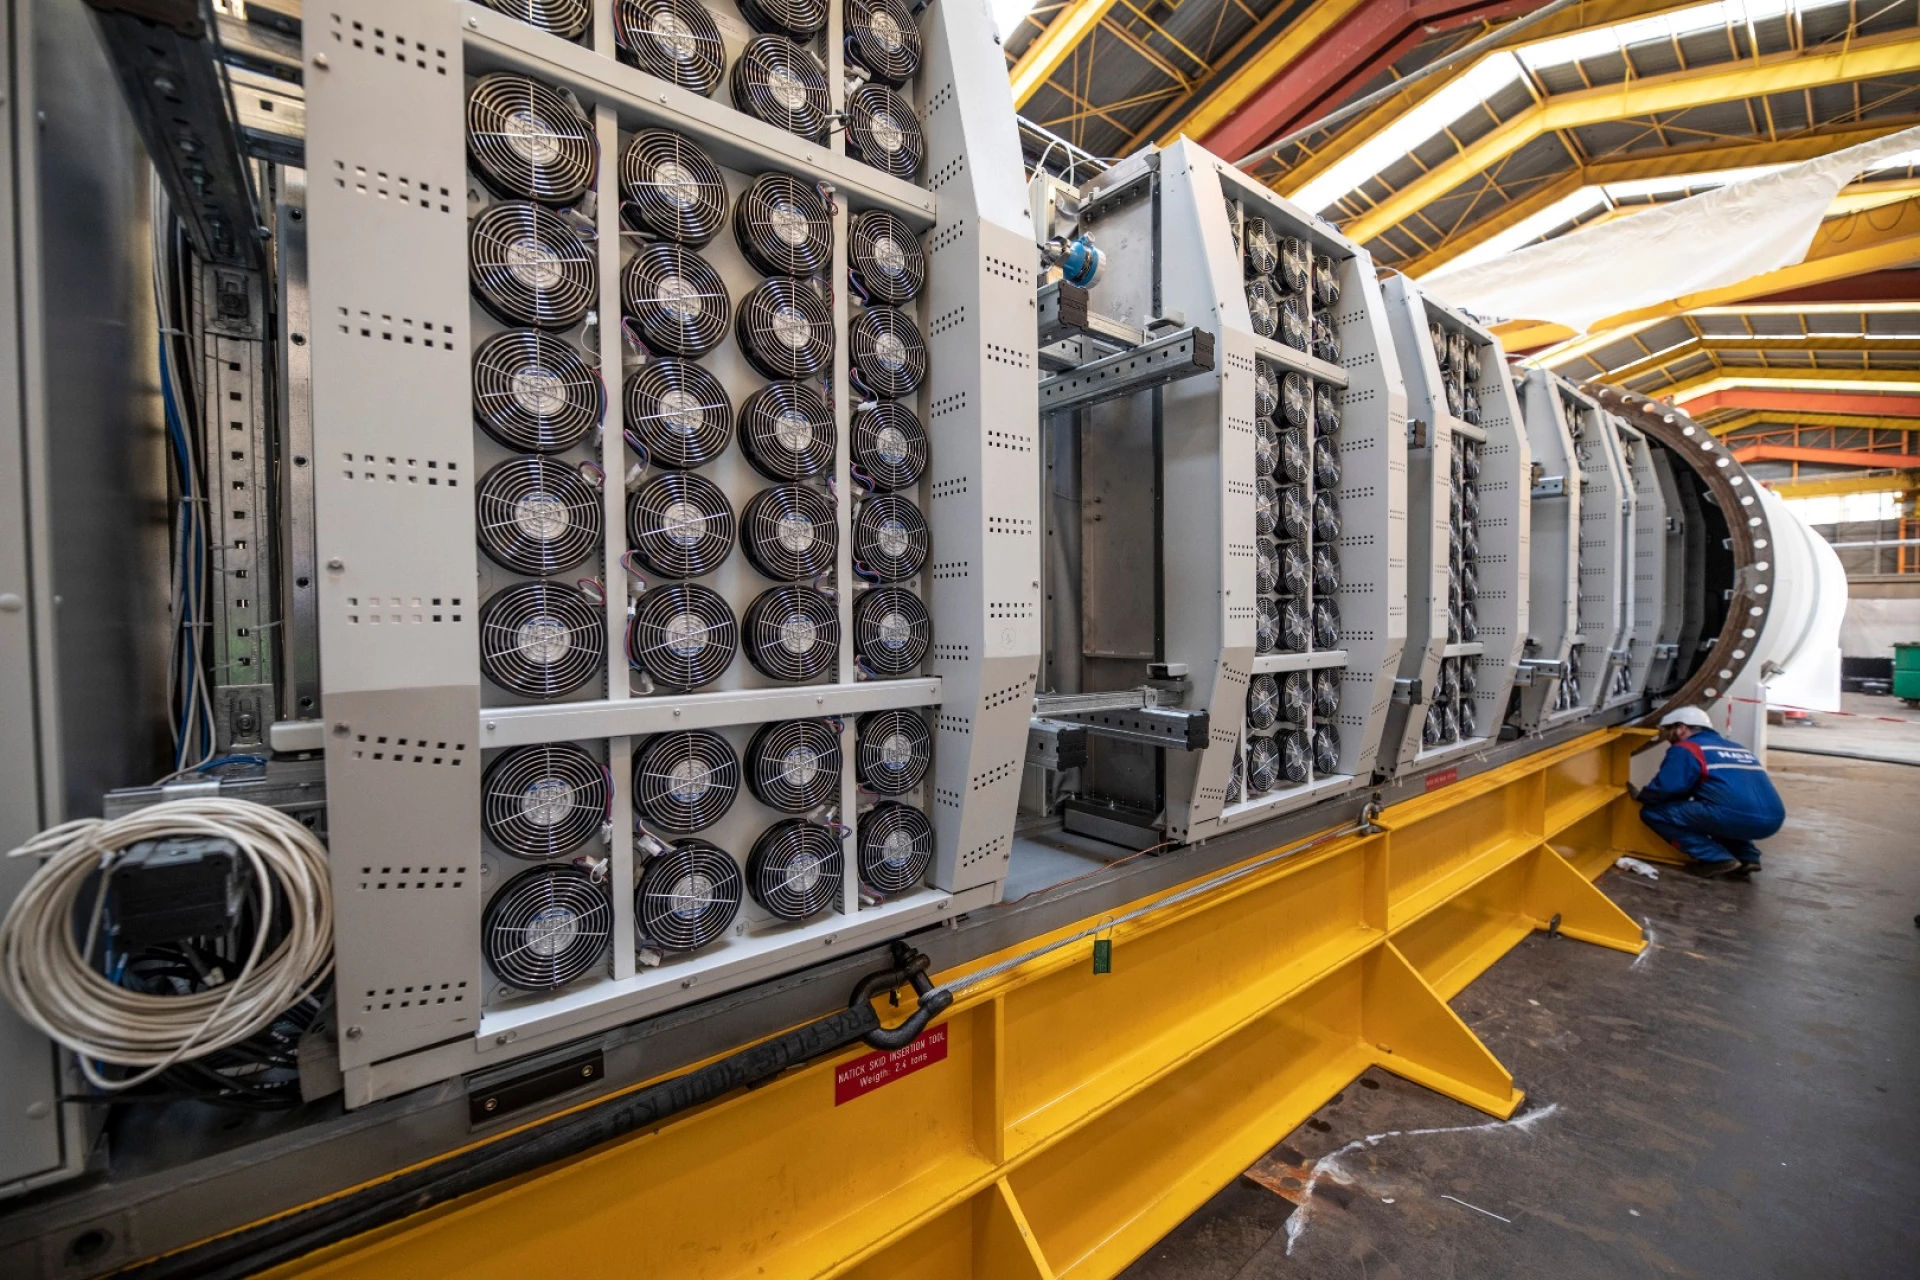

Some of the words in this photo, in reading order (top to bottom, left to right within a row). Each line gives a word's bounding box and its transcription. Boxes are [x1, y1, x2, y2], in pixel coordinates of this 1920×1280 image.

[838, 1064, 866, 1084] NATICK
[869, 1056, 886, 1071] SKID
[889, 1039, 926, 1062] INSERTION
[928, 1031, 945, 1045] TOOL
[860, 1069, 891, 1087] Weigth:
[895, 1059, 907, 1072] 2.4
[910, 1053, 928, 1065] tons
